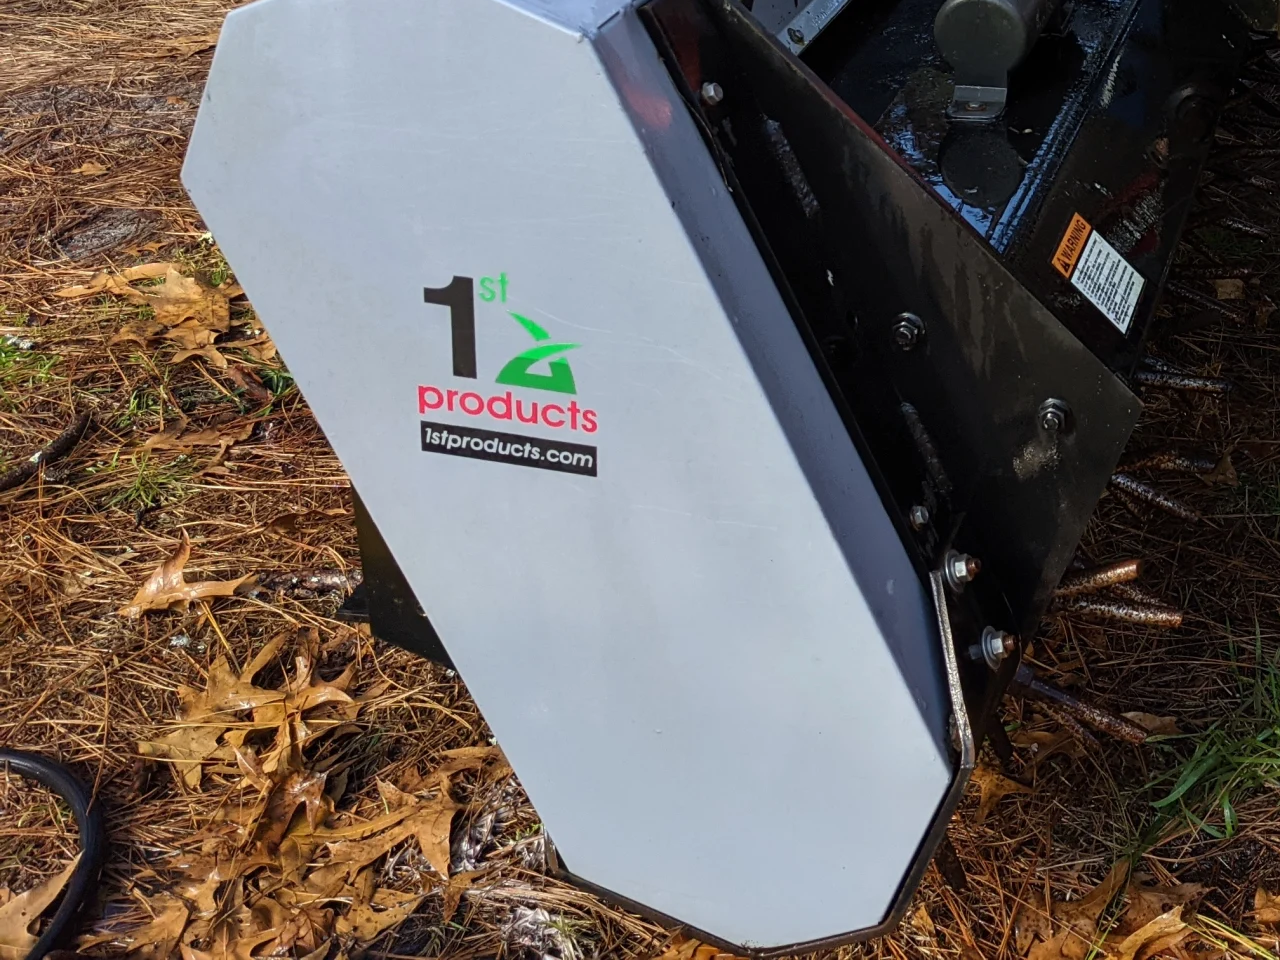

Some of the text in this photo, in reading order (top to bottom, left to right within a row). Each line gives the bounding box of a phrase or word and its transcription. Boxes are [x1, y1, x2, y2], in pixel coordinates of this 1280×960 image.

[1061, 219, 1086, 259] WARNING
[423, 271, 509, 380] 1st
[417, 384, 598, 434] products
[424, 427, 594, 469] 1stproducts.com
